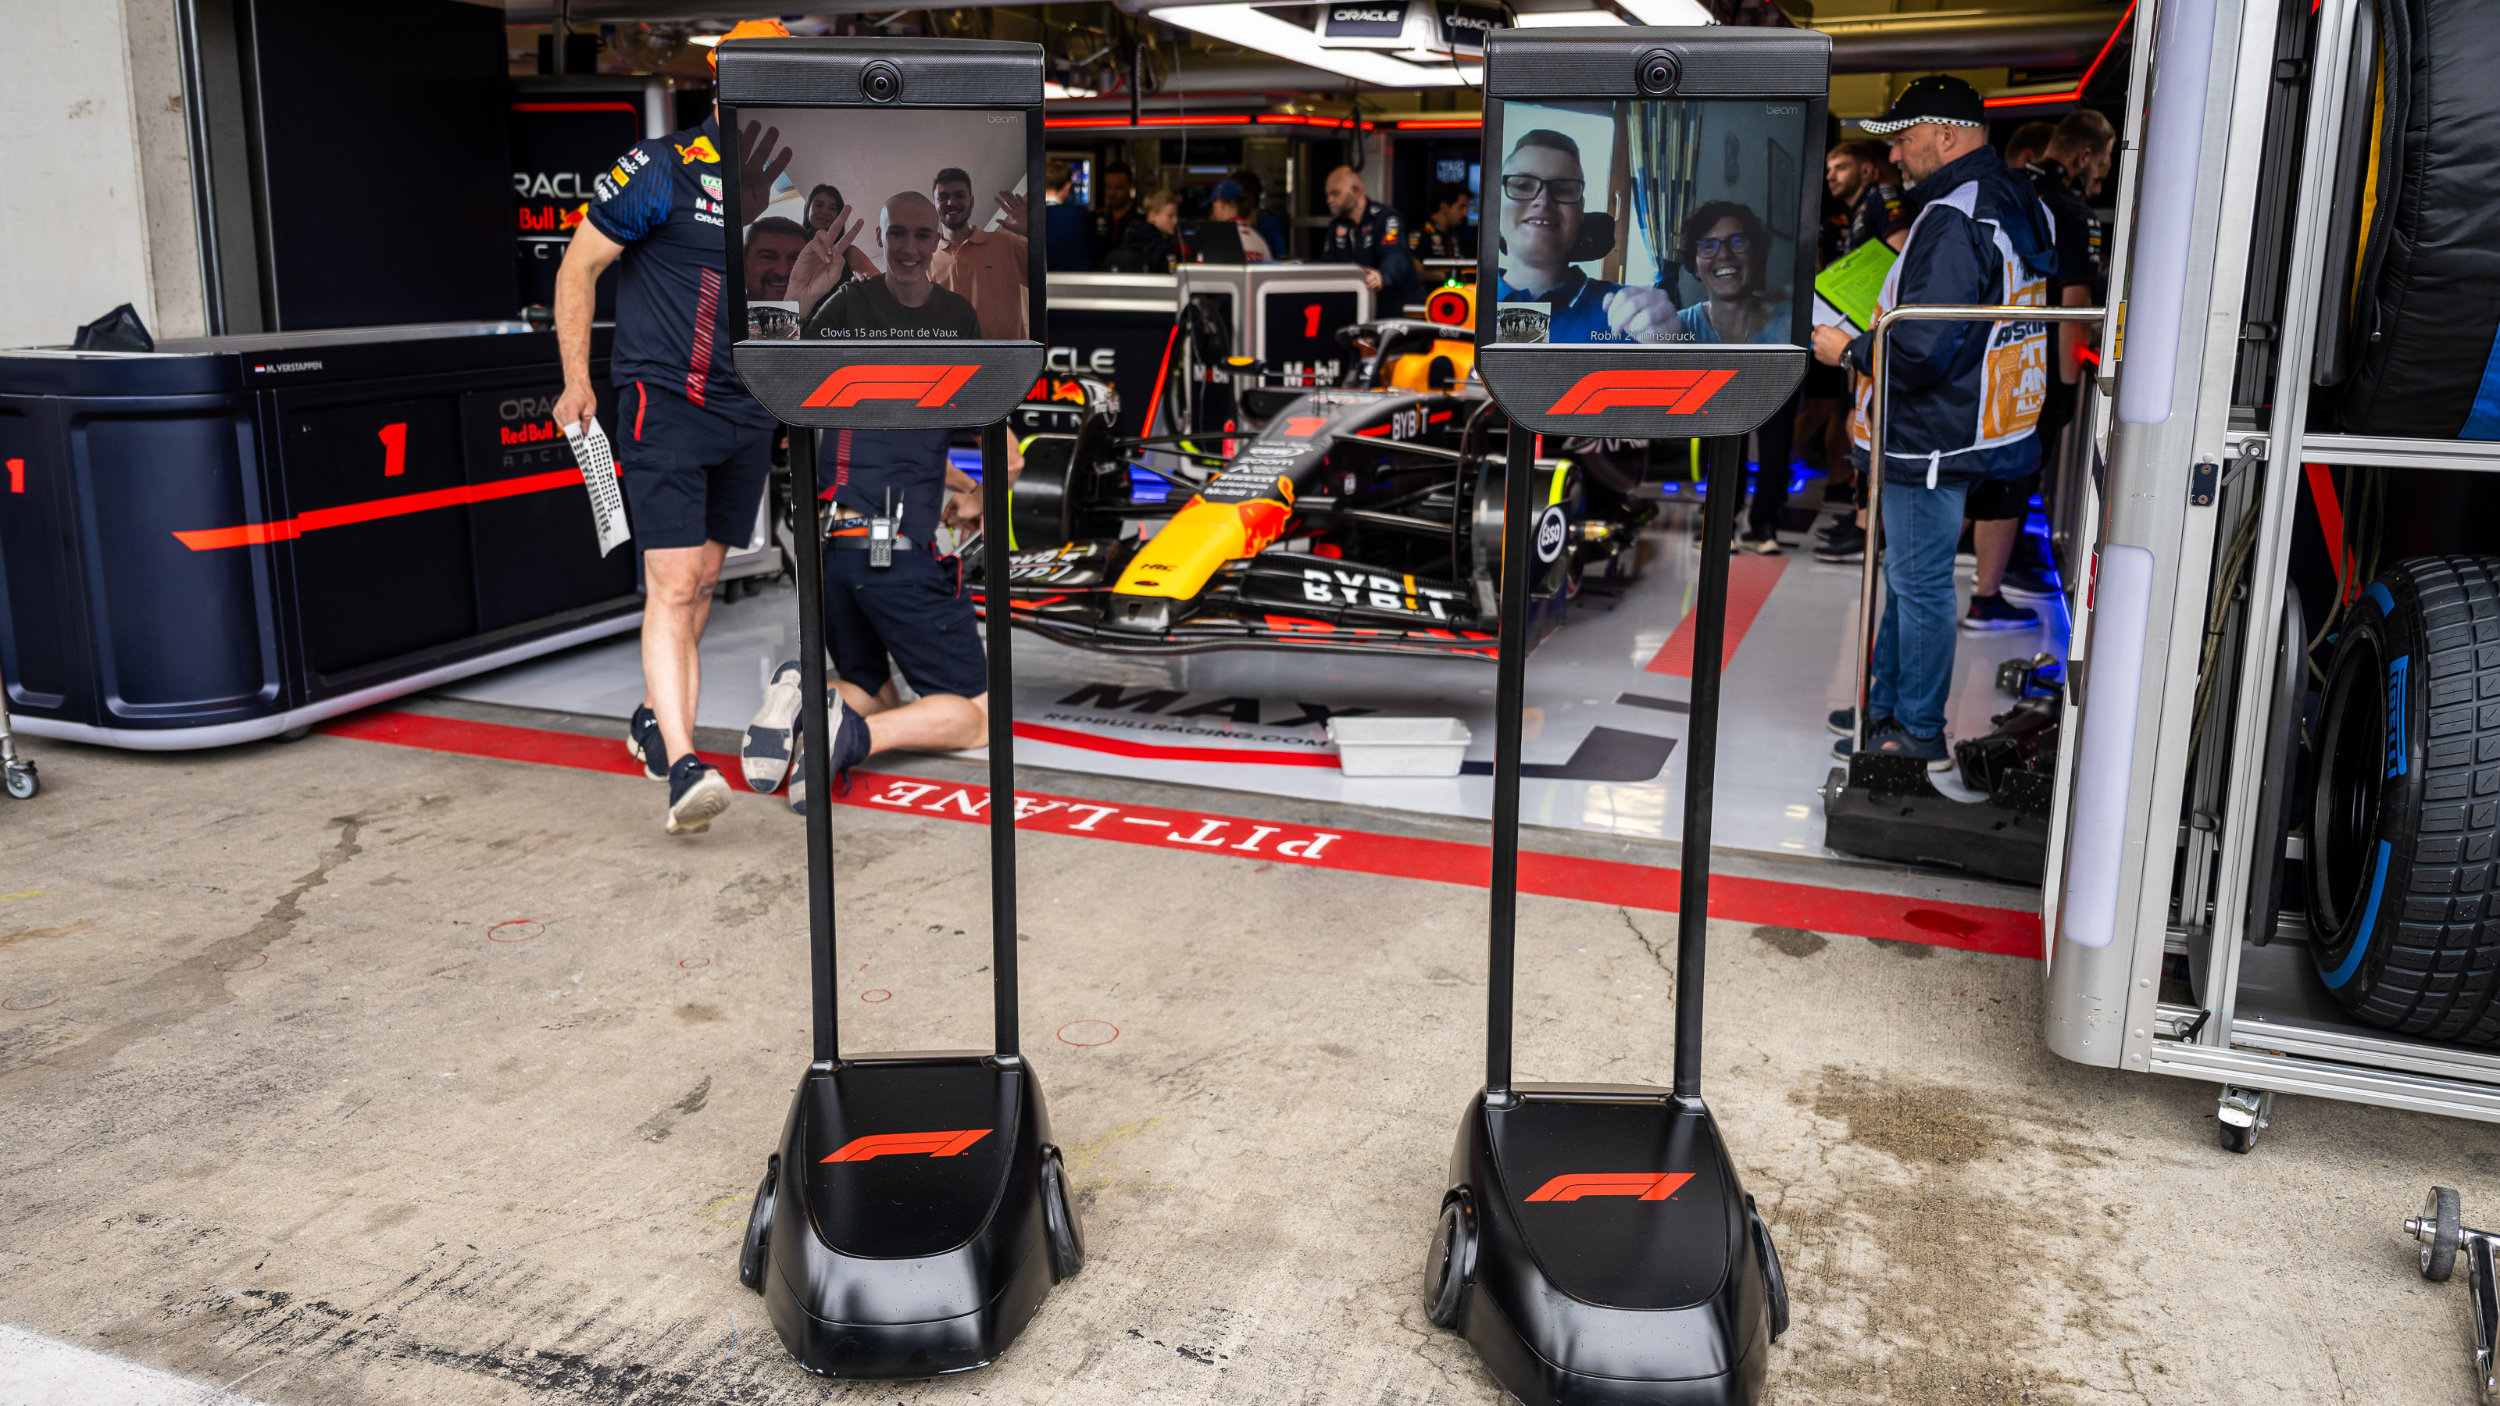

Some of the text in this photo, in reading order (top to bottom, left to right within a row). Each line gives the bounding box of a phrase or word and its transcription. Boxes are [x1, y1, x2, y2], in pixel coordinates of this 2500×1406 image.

[1333, 9, 1400, 22] ORACLE
[987, 112, 1018, 124] beam
[1766, 103, 1798, 115] beam
[513, 172, 606, 199] RACL
[519, 206, 555, 231] Bull
[694, 212, 724, 228] ORAC
[695, 197, 724, 215] Mobi
[820, 327, 959, 338] Clovis 15 ans Pont de Vaux
[1304, 304, 1323, 338] 1
[1590, 330, 1622, 341] Robin
[266, 361, 323, 374] M. VERSTAPPEN
[1046, 346, 1116, 374] CLE
[800, 364, 982, 407] F1
[1544, 369, 1739, 415] F1
[500, 396, 562, 420] ORA
[1392, 402, 1430, 441] BYBIT
[378, 421, 407, 478] 1
[5, 458, 25, 494] 1
[1302, 568, 1454, 620] BYBIT
[1054, 682, 1380, 731] MAX
[2386, 654, 2409, 780] PIRELLI
[1043, 711, 1329, 749] REDBULLRACING.COM
[869, 779, 1342, 860] PIT-LANE
[818, 1128, 995, 1164] F1
[1523, 1172, 1697, 1202] F1
